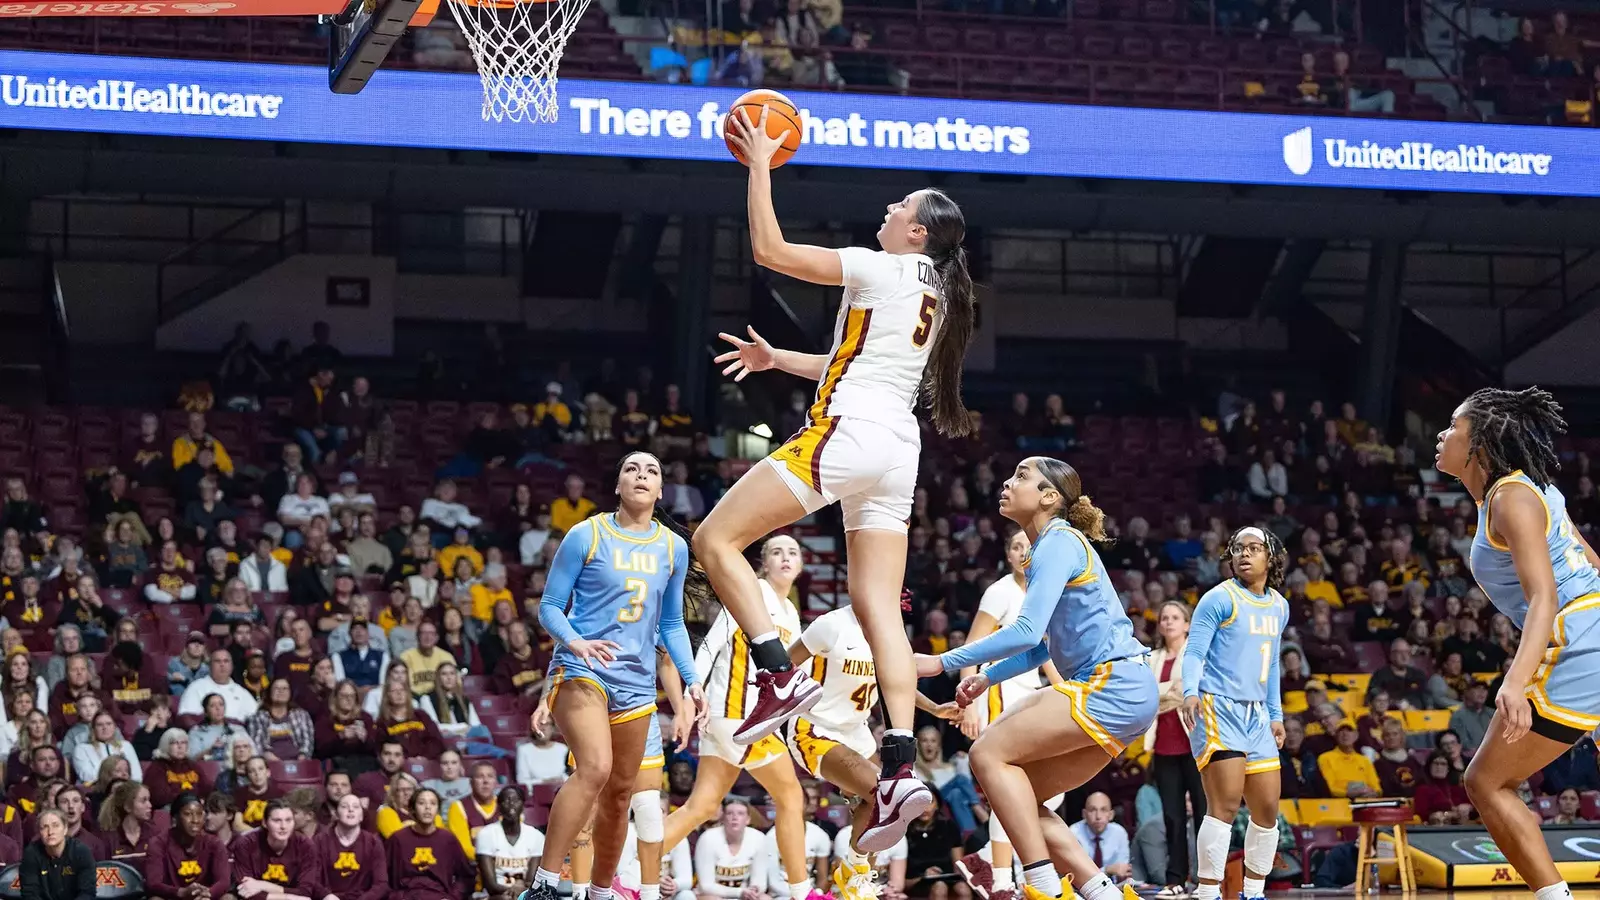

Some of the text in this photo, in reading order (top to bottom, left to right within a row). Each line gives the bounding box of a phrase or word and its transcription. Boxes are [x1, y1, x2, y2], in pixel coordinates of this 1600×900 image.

[0, 75, 283, 118] UnitedHealthcare
[570, 98, 692, 139] There
[873, 115, 1031, 155] matters
[1323, 139, 1551, 175] UnitedHealthcare
[911, 292, 938, 350] 5
[613, 547, 658, 575] LIU
[617, 576, 648, 623] 3
[1249, 613, 1279, 637] LIU
[1259, 640, 1272, 684] 1
